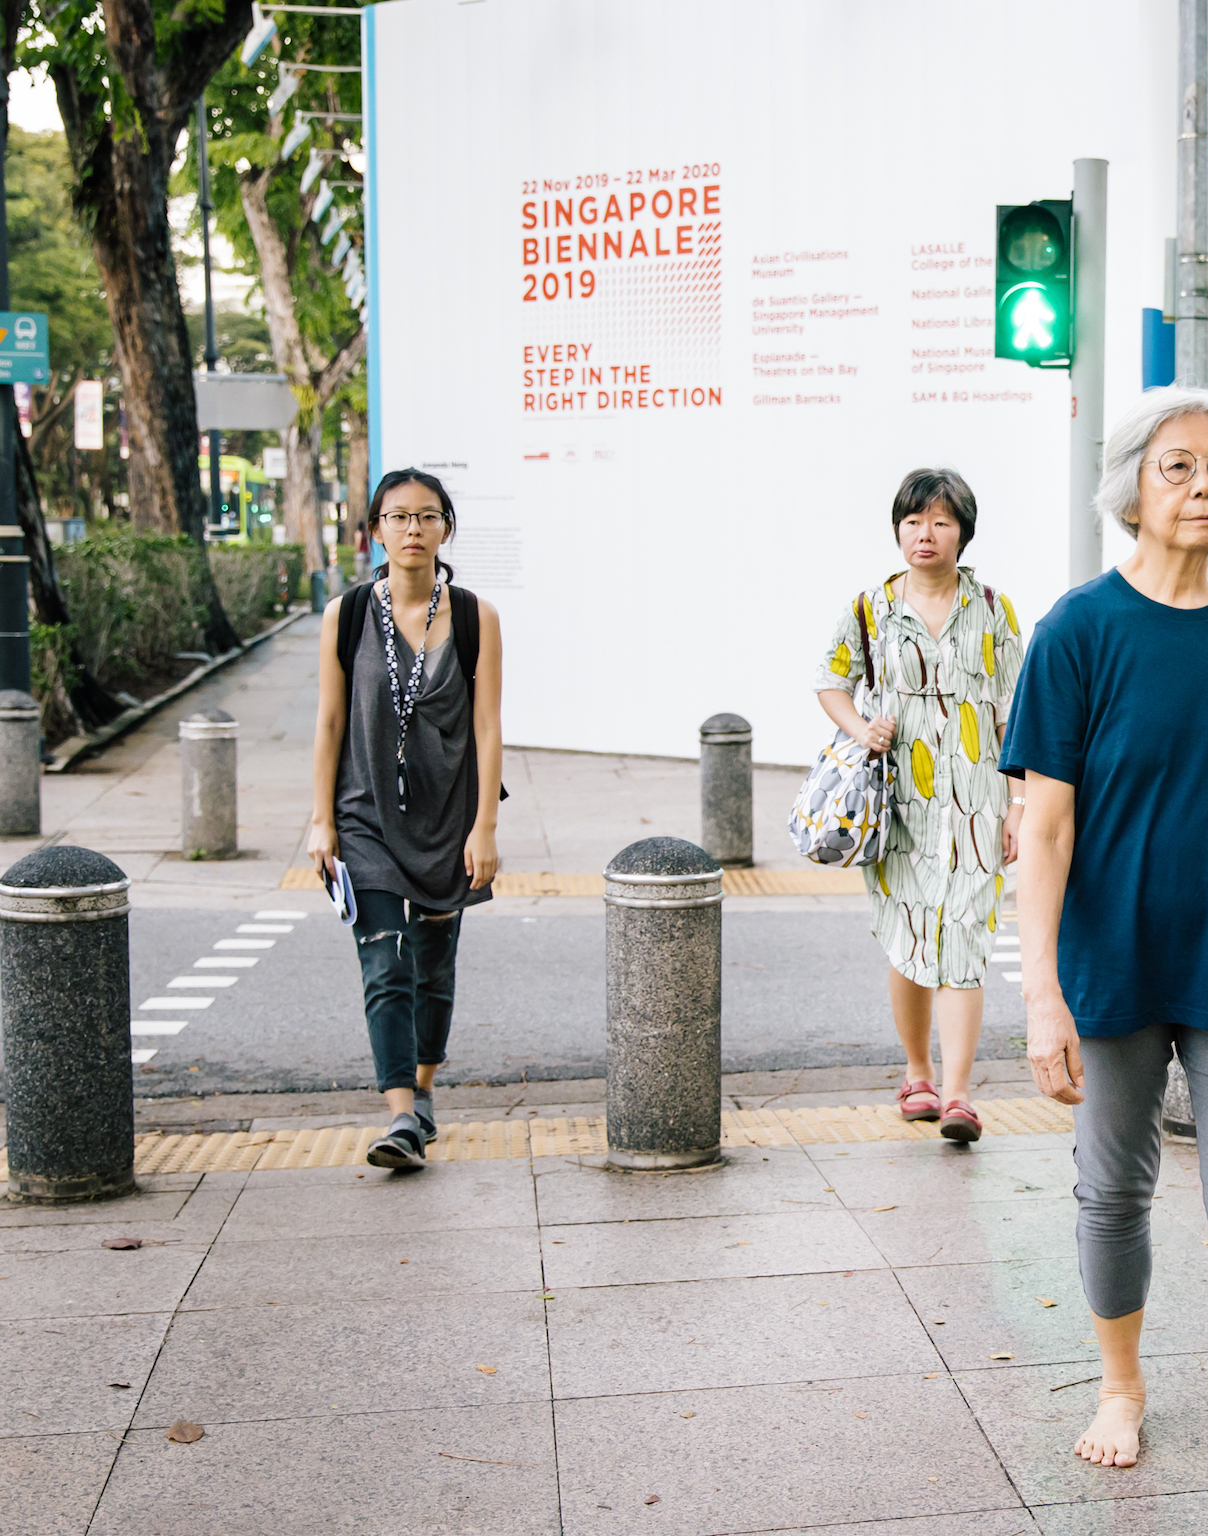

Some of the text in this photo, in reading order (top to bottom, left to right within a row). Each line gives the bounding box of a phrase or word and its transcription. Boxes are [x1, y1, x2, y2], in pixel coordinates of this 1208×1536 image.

[523, 181, 538, 194] 22
[543, 179, 570, 192] Nov
[576, 174, 609, 190] 2019
[627, 170, 643, 184] 22
[649, 169, 676, 183] Mar
[683, 163, 721, 180] 2020
[522, 184, 721, 230] SINGAPORE
[522, 225, 694, 265] BIENNALE
[911, 242, 965, 256] LASALLE
[752, 250, 849, 264] Asian Civilisations
[912, 256, 993, 271] College of the
[752, 268, 795, 278] Museum
[523, 269, 595, 302] 2019
[912, 286, 993, 299] National Galle
[752, 297, 765, 307] de
[812, 293, 850, 305] Gallery
[752, 306, 879, 322] Singapore Management
[912, 315, 993, 329] National Libra
[752, 323, 805, 336] University
[524, 344, 593, 364] EVERY
[753, 352, 806, 364] Esplanade
[912, 346, 993, 359] National Muse
[753, 364, 859, 377] Theatres on the Bay
[912, 362, 985, 375] of Singapore
[524, 365, 651, 387] STEP IN THE
[524, 387, 722, 411] RIGHT DIRECTION
[795, 394, 841, 404] Barracks
[912, 392, 937, 402] SAM
[941, 391, 948, 402] &
[973, 390, 1032, 403] Hoardings
